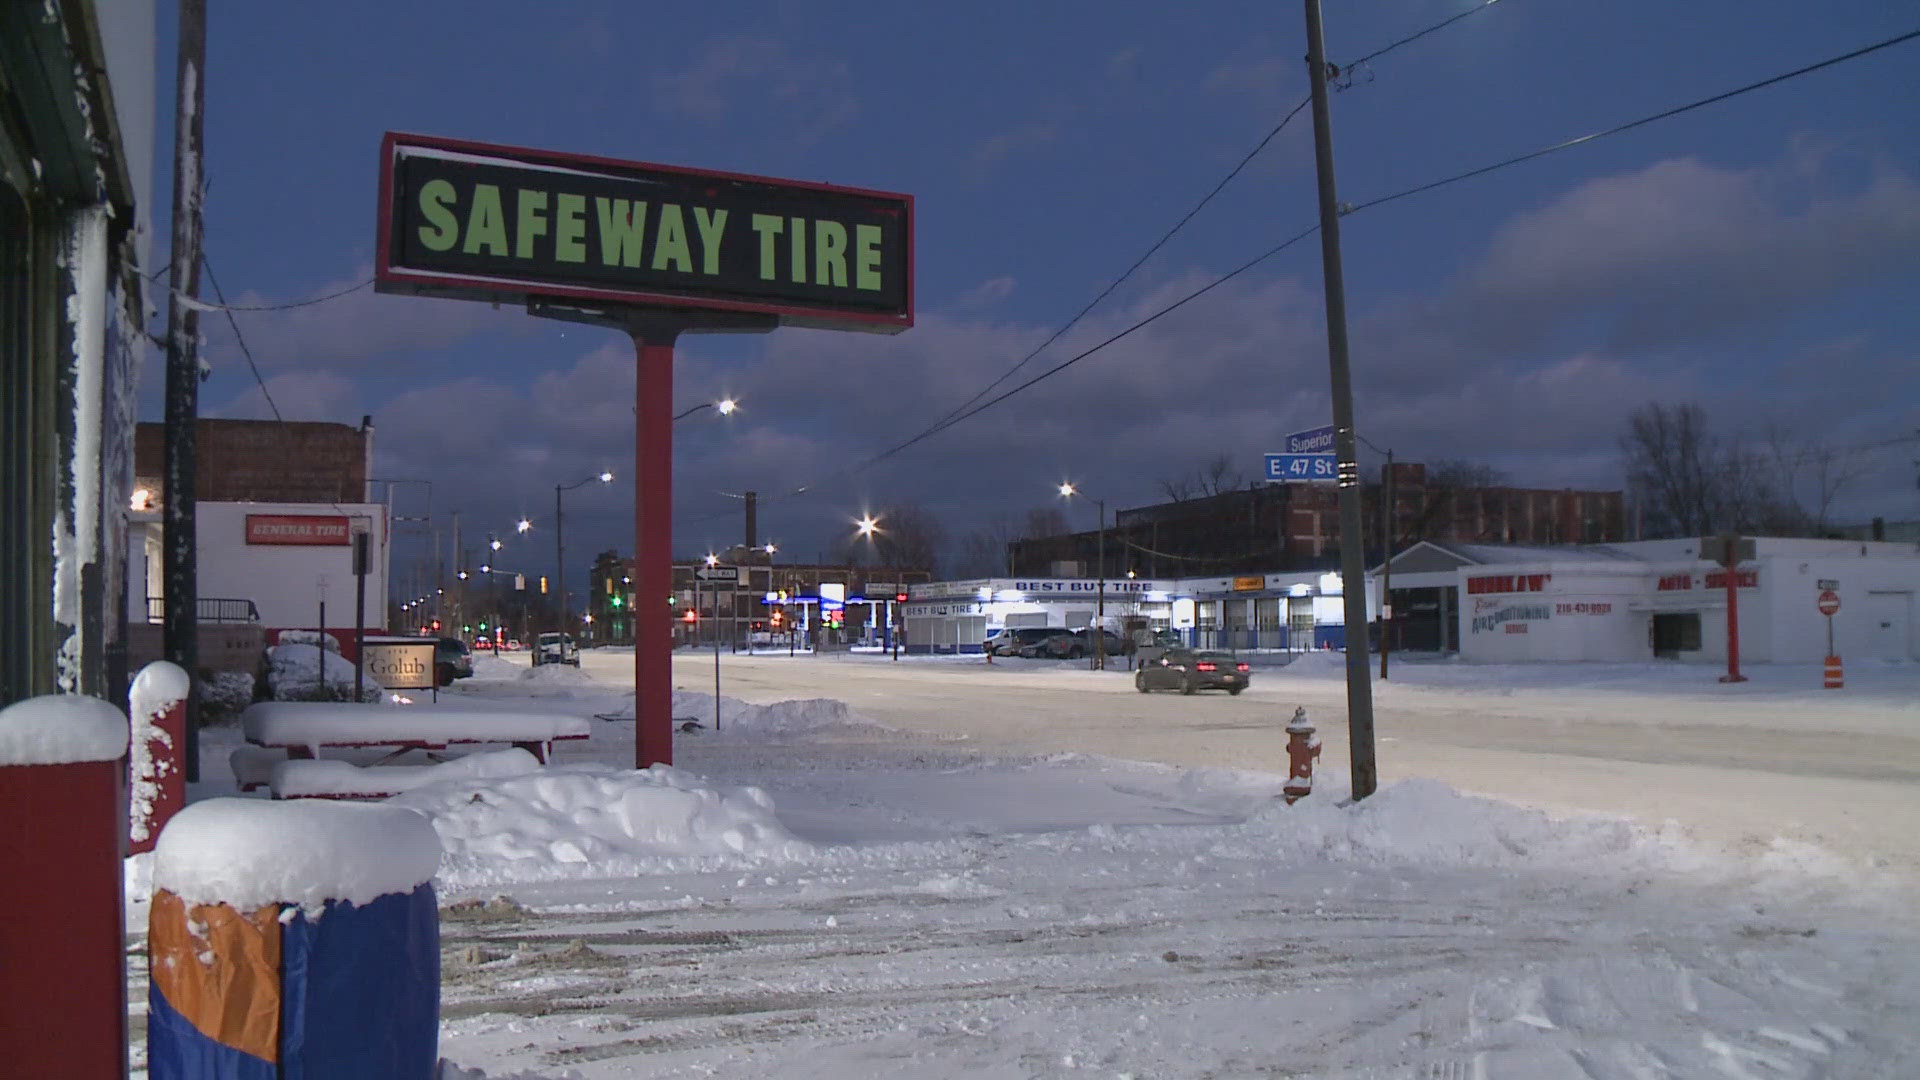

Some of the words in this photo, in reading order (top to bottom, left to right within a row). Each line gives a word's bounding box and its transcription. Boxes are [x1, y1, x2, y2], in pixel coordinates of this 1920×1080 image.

[418, 179, 728, 275] SAFEWAY
[752, 213, 882, 291] TIRE
[1291, 433, 1333, 453] Superior
[1270, 459, 1285, 475] E.
[1290, 459, 1309, 474] 47
[1315, 459, 1333, 475] St
[253, 525, 312, 535] GENERAL
[316, 525, 346, 536] TIRE
[1015, 582, 1064, 591] BEST
[1071, 582, 1106, 591] BUY
[1113, 583, 1152, 591] TIRE
[907, 607, 927, 616] BEST
[930, 605, 947, 615] BUY
[952, 604, 972, 614] TIRE
[370, 657, 424, 674] Golub
